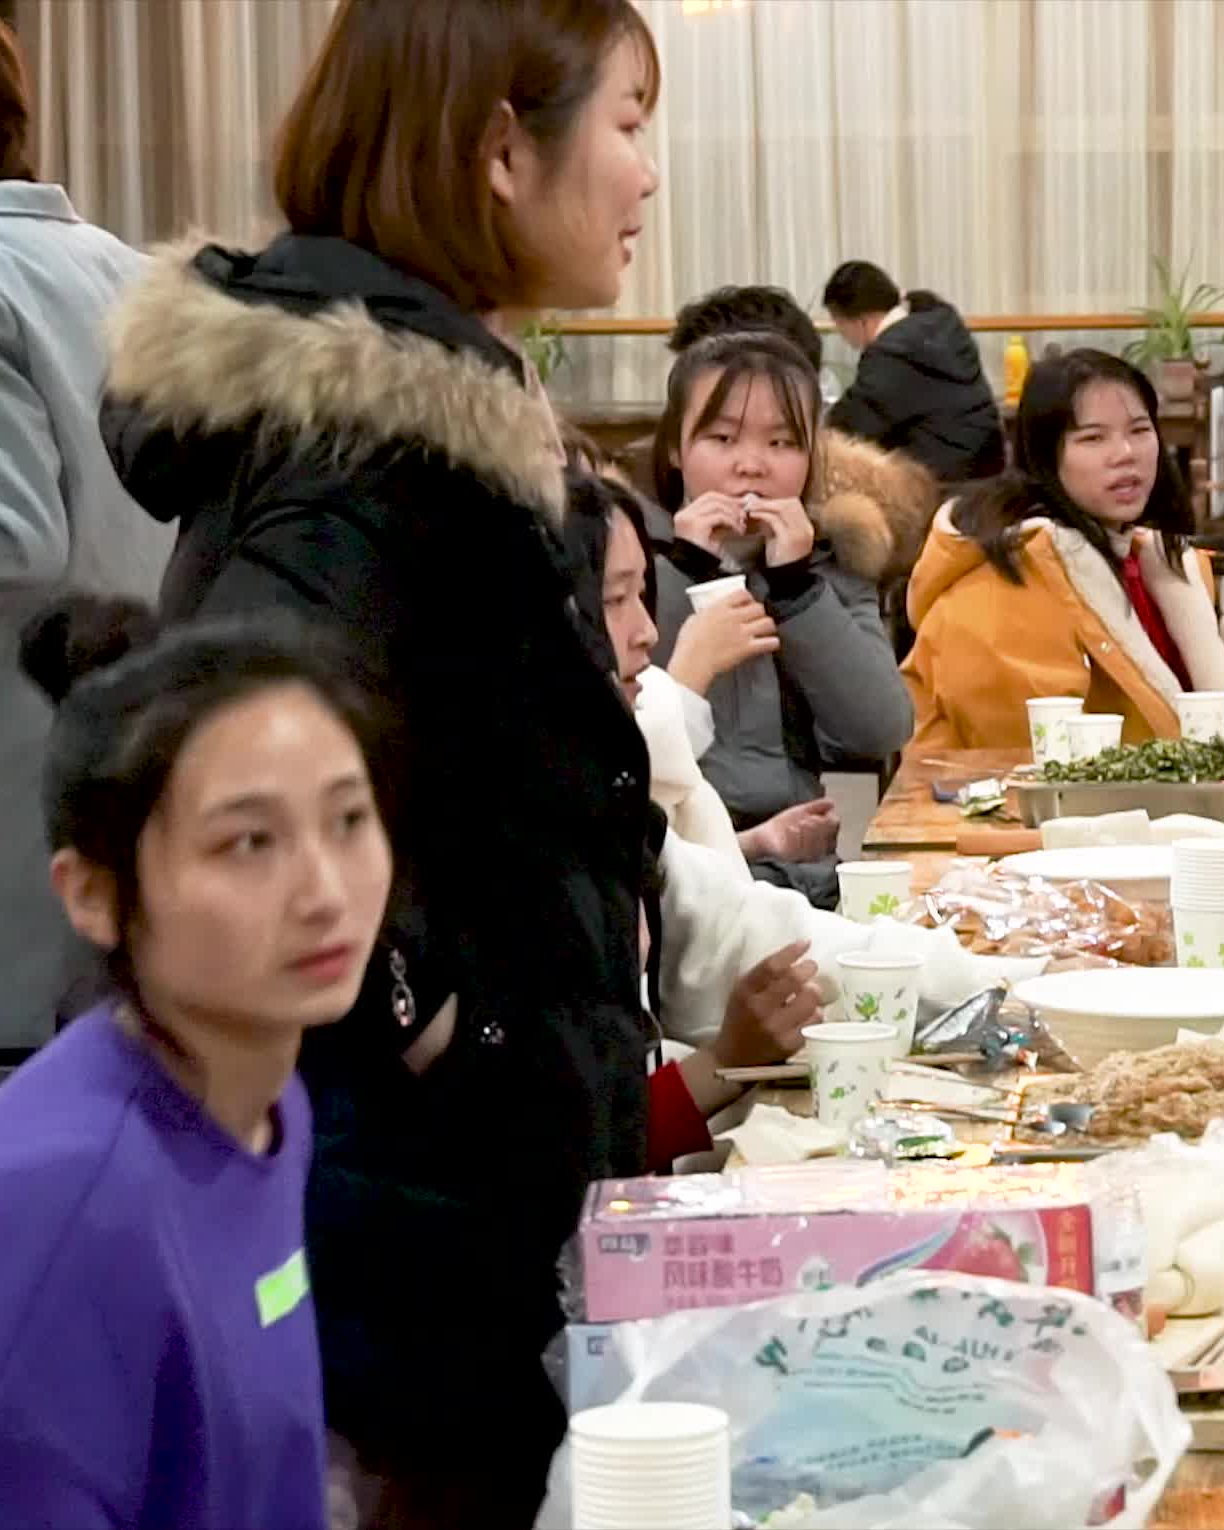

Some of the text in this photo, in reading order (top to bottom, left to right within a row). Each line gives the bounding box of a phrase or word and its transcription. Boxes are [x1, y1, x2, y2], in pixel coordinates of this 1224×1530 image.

[663, 1256, 784, 1289] 风味酸牛奶
